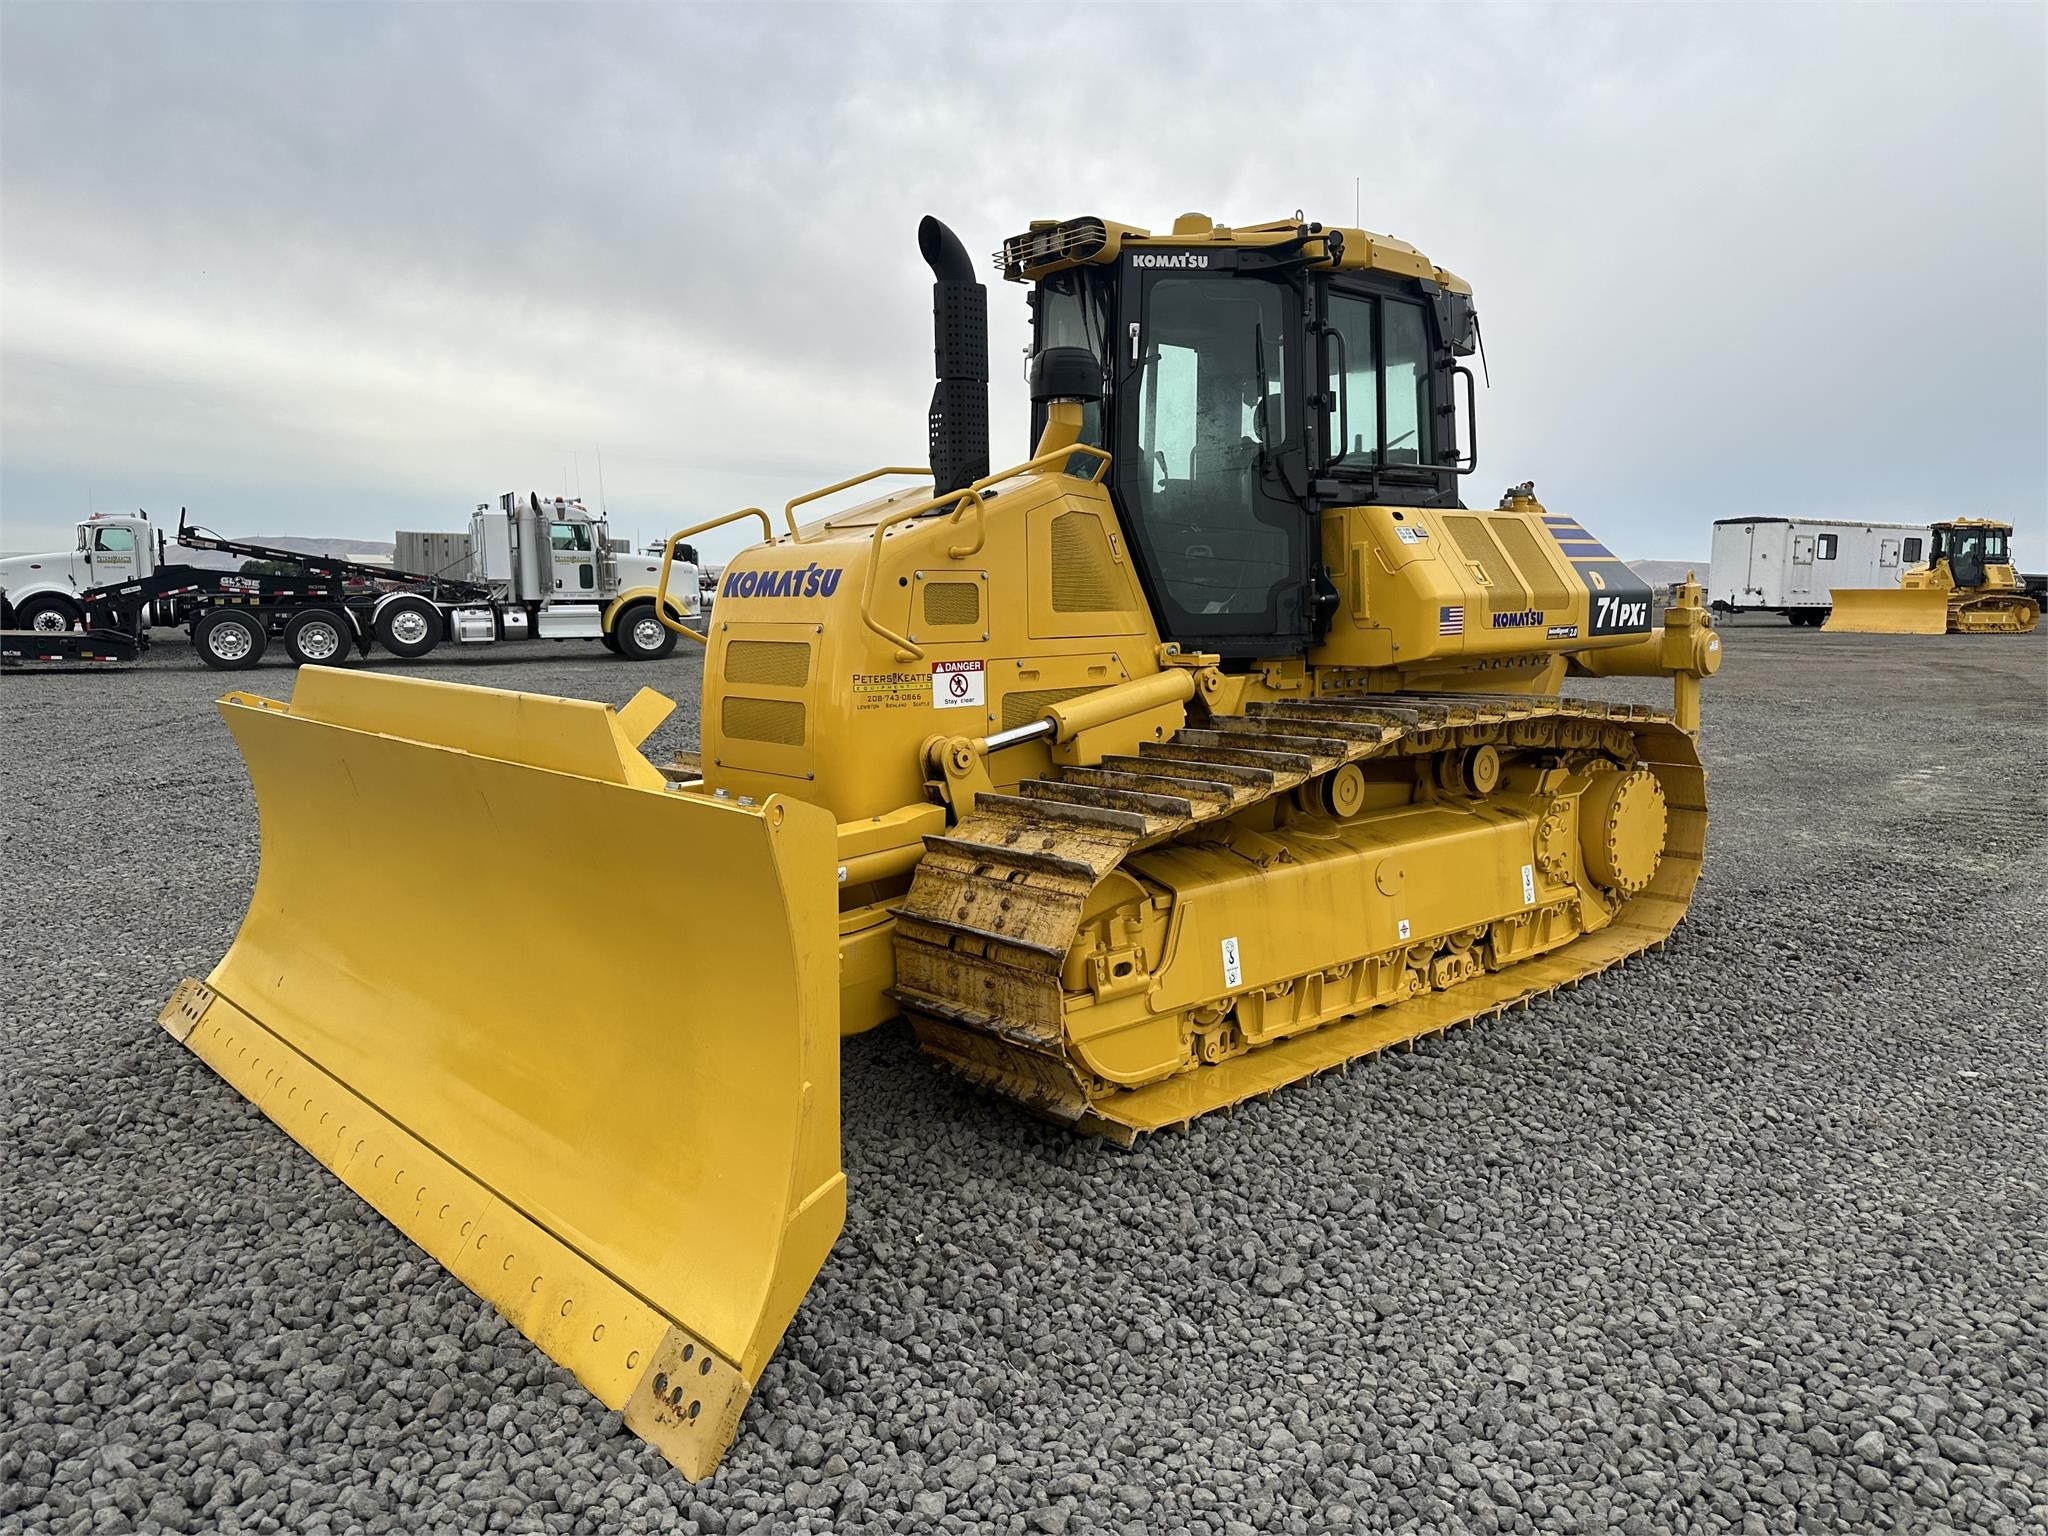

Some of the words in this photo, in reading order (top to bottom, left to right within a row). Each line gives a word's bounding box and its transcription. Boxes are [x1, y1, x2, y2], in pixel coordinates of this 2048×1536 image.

[1133, 252, 1208, 268] KOMATSU
[220, 576, 261, 586] GLOBE
[723, 562, 843, 598] KOMATSU
[1588, 571, 1606, 591] D
[1493, 608, 1543, 627] KOMATSU
[1596, 597, 1647, 628] 71PXi
[945, 661, 981, 672] DANGER
[853, 674, 893, 684] PETERS
[897, 673, 933, 683] KEATTS
